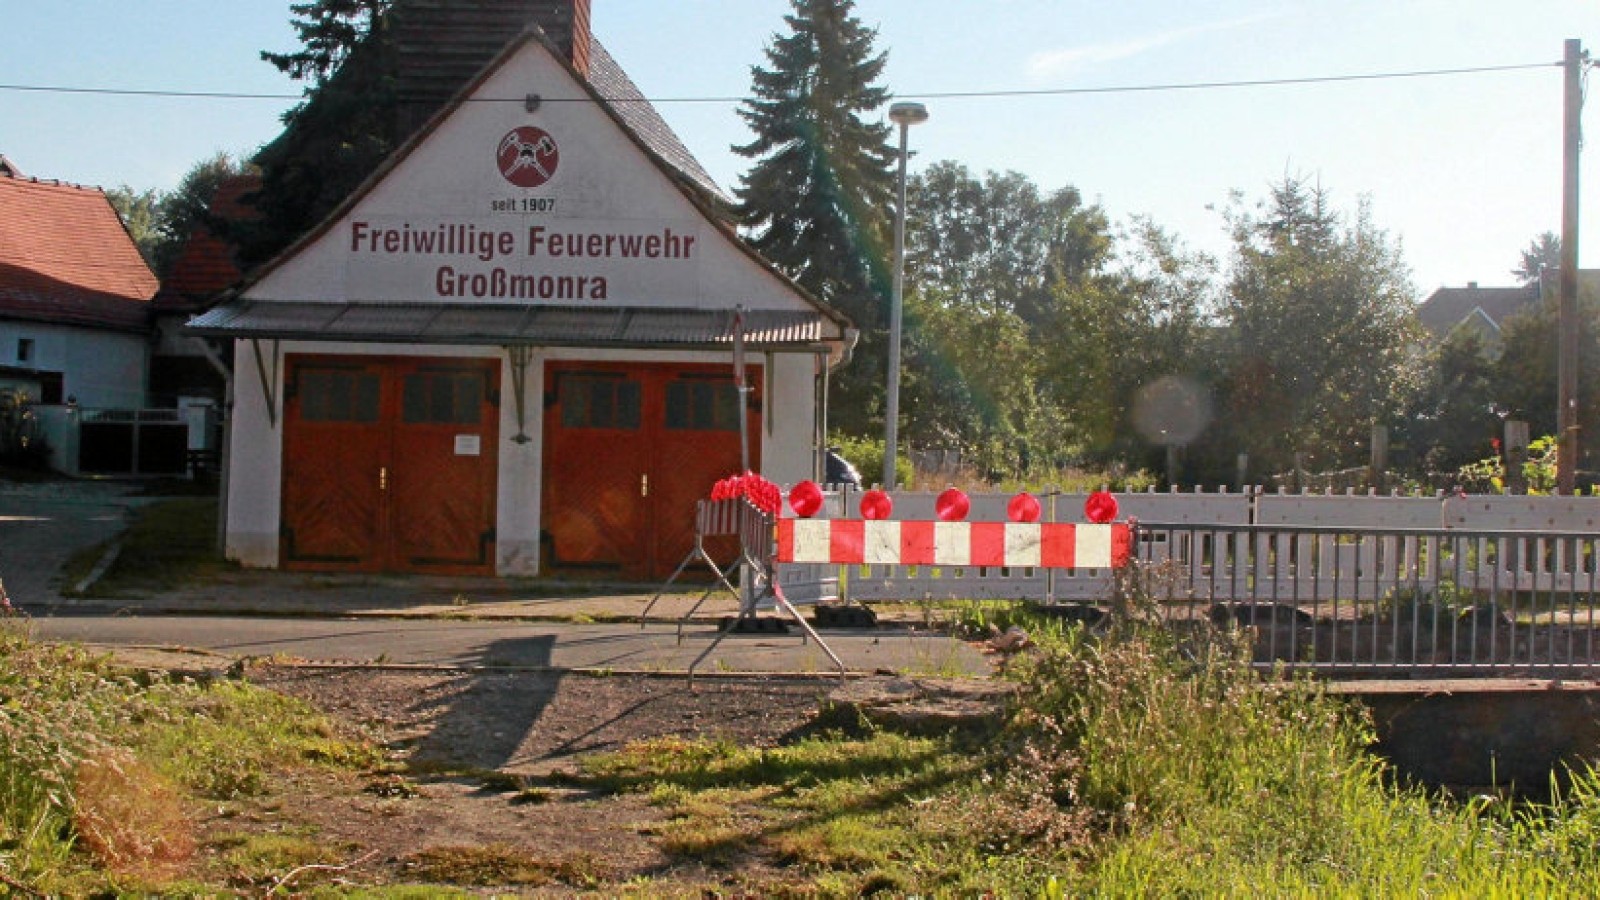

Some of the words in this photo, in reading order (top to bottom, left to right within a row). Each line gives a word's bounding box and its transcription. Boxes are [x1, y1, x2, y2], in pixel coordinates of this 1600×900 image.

[491, 198, 516, 211] seit
[522, 199, 555, 211] 1907
[351, 222, 514, 261] Freiwillige
[528, 226, 695, 259] Feuerwehr
[436, 266, 607, 299] Großmonra
